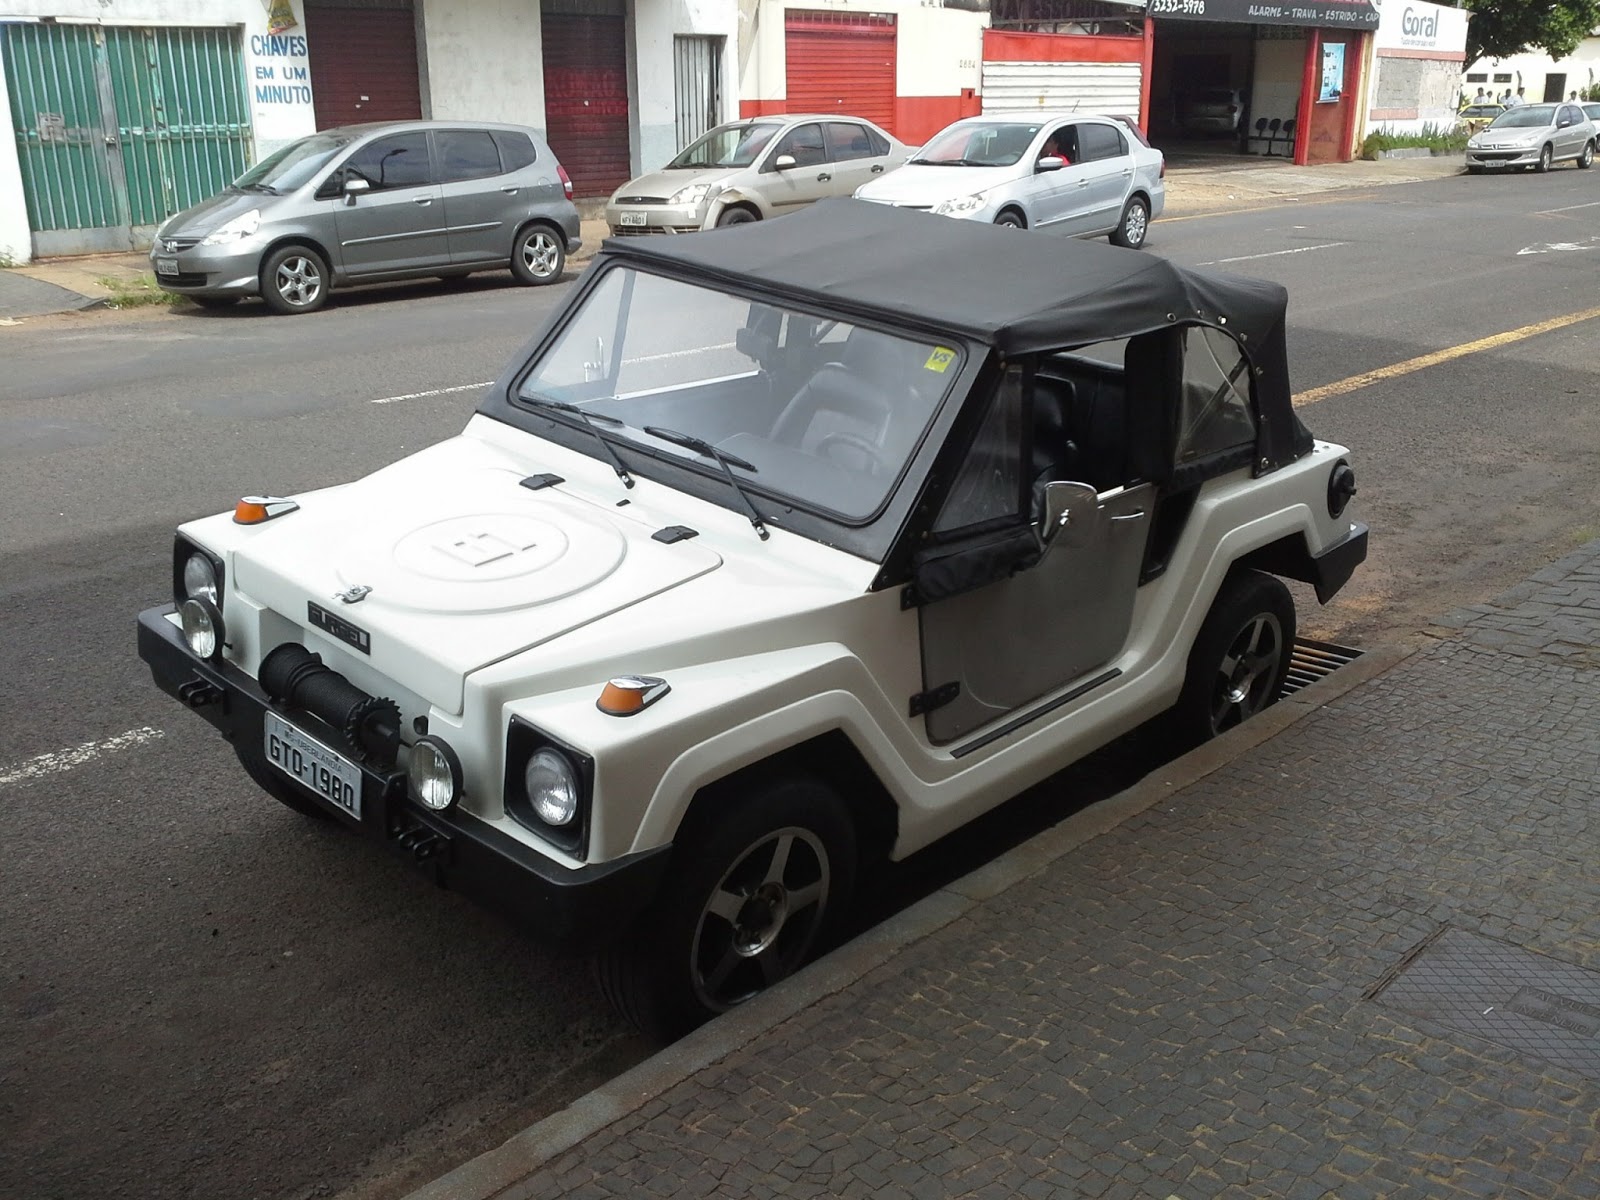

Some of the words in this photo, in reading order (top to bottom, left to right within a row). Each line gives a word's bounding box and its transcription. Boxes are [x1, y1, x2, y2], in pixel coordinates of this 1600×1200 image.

[1153, 0, 1205, 14] 3232-5978
[1248, 5, 1282, 17] ALARME
[1292, 8, 1317, 19] TRAVA
[1325, 10, 1358, 21] ESTRIBO
[1402, 6, 1439, 38] Coral
[251, 34, 307, 57] CHAVES
[255, 66, 274, 80] EM
[283, 66, 307, 80] UM
[255, 85, 311, 104] MINUTO
[270, 733, 355, 811] GTO-1980
